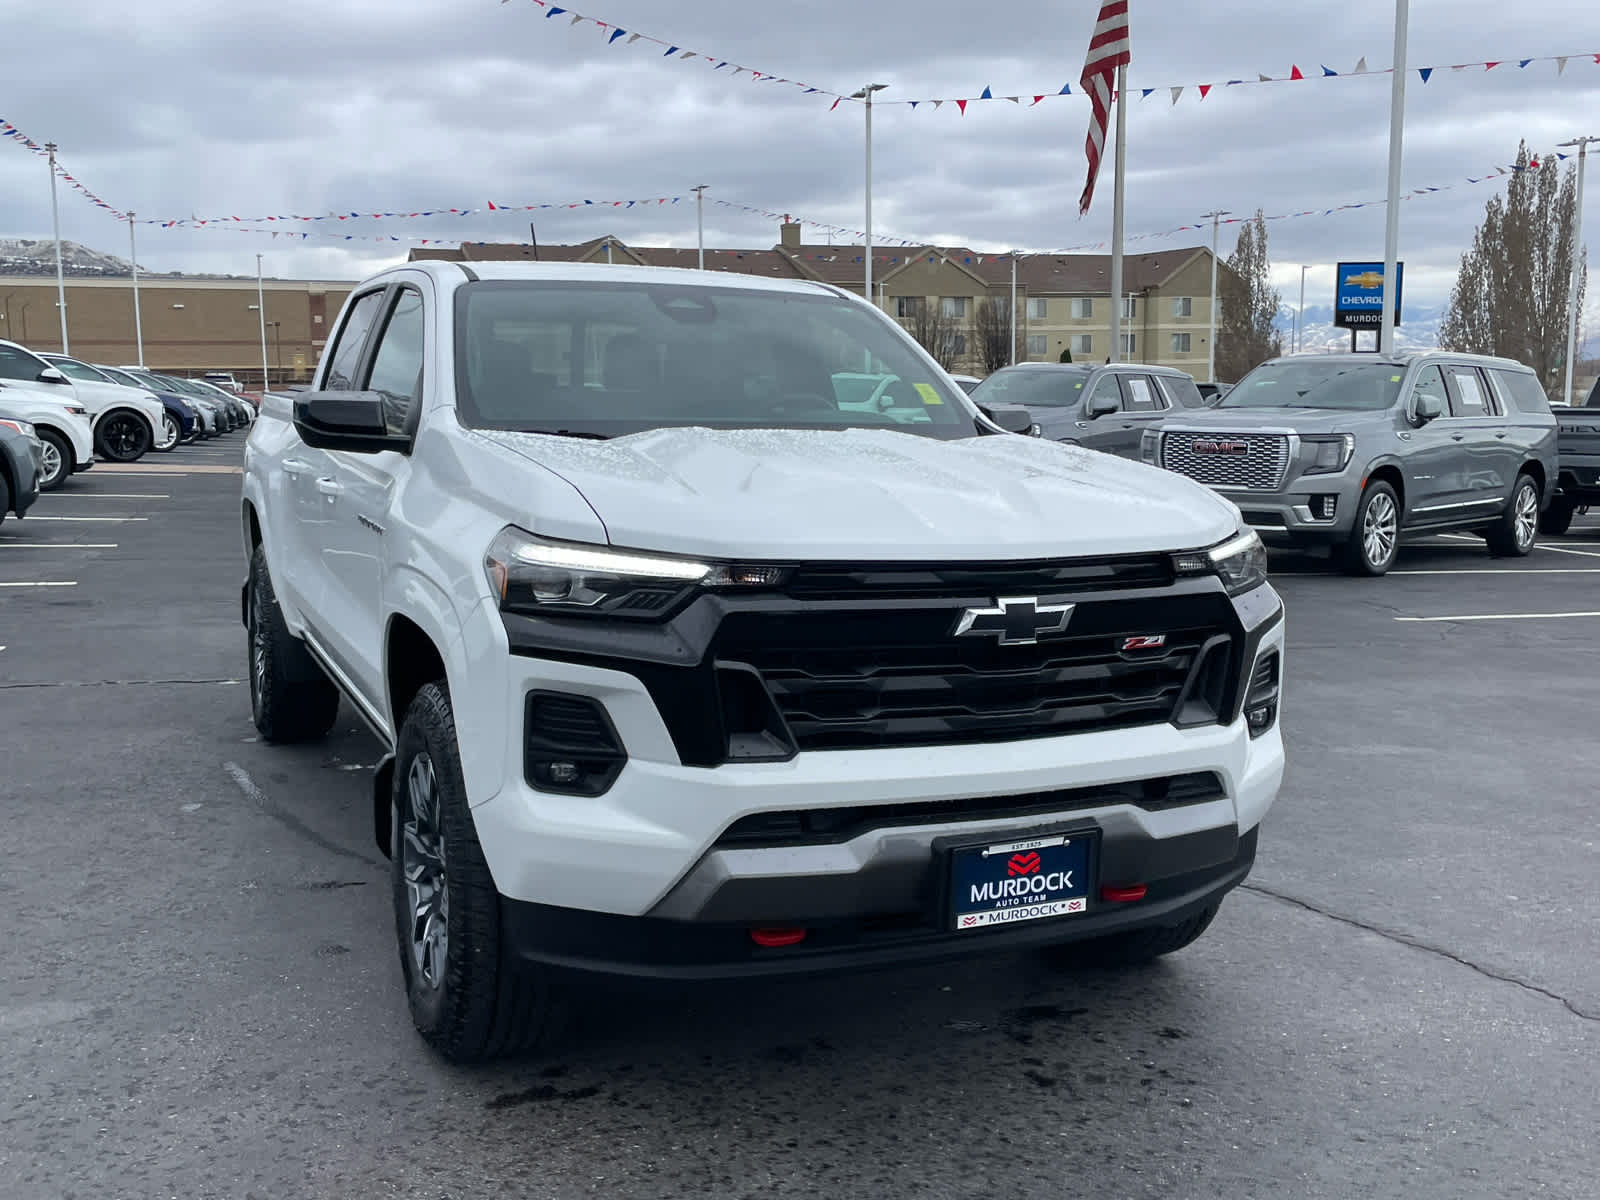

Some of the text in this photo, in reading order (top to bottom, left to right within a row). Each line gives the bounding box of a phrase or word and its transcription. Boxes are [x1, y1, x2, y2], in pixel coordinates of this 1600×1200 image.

[1342, 296, 1384, 304] CHEVROL
[1192, 441, 1247, 454] GMC
[970, 870, 1073, 903] MURDOCK
[996, 894, 1047, 908] AUTO TEAM
[988, 903, 1058, 923] MURDOCK
